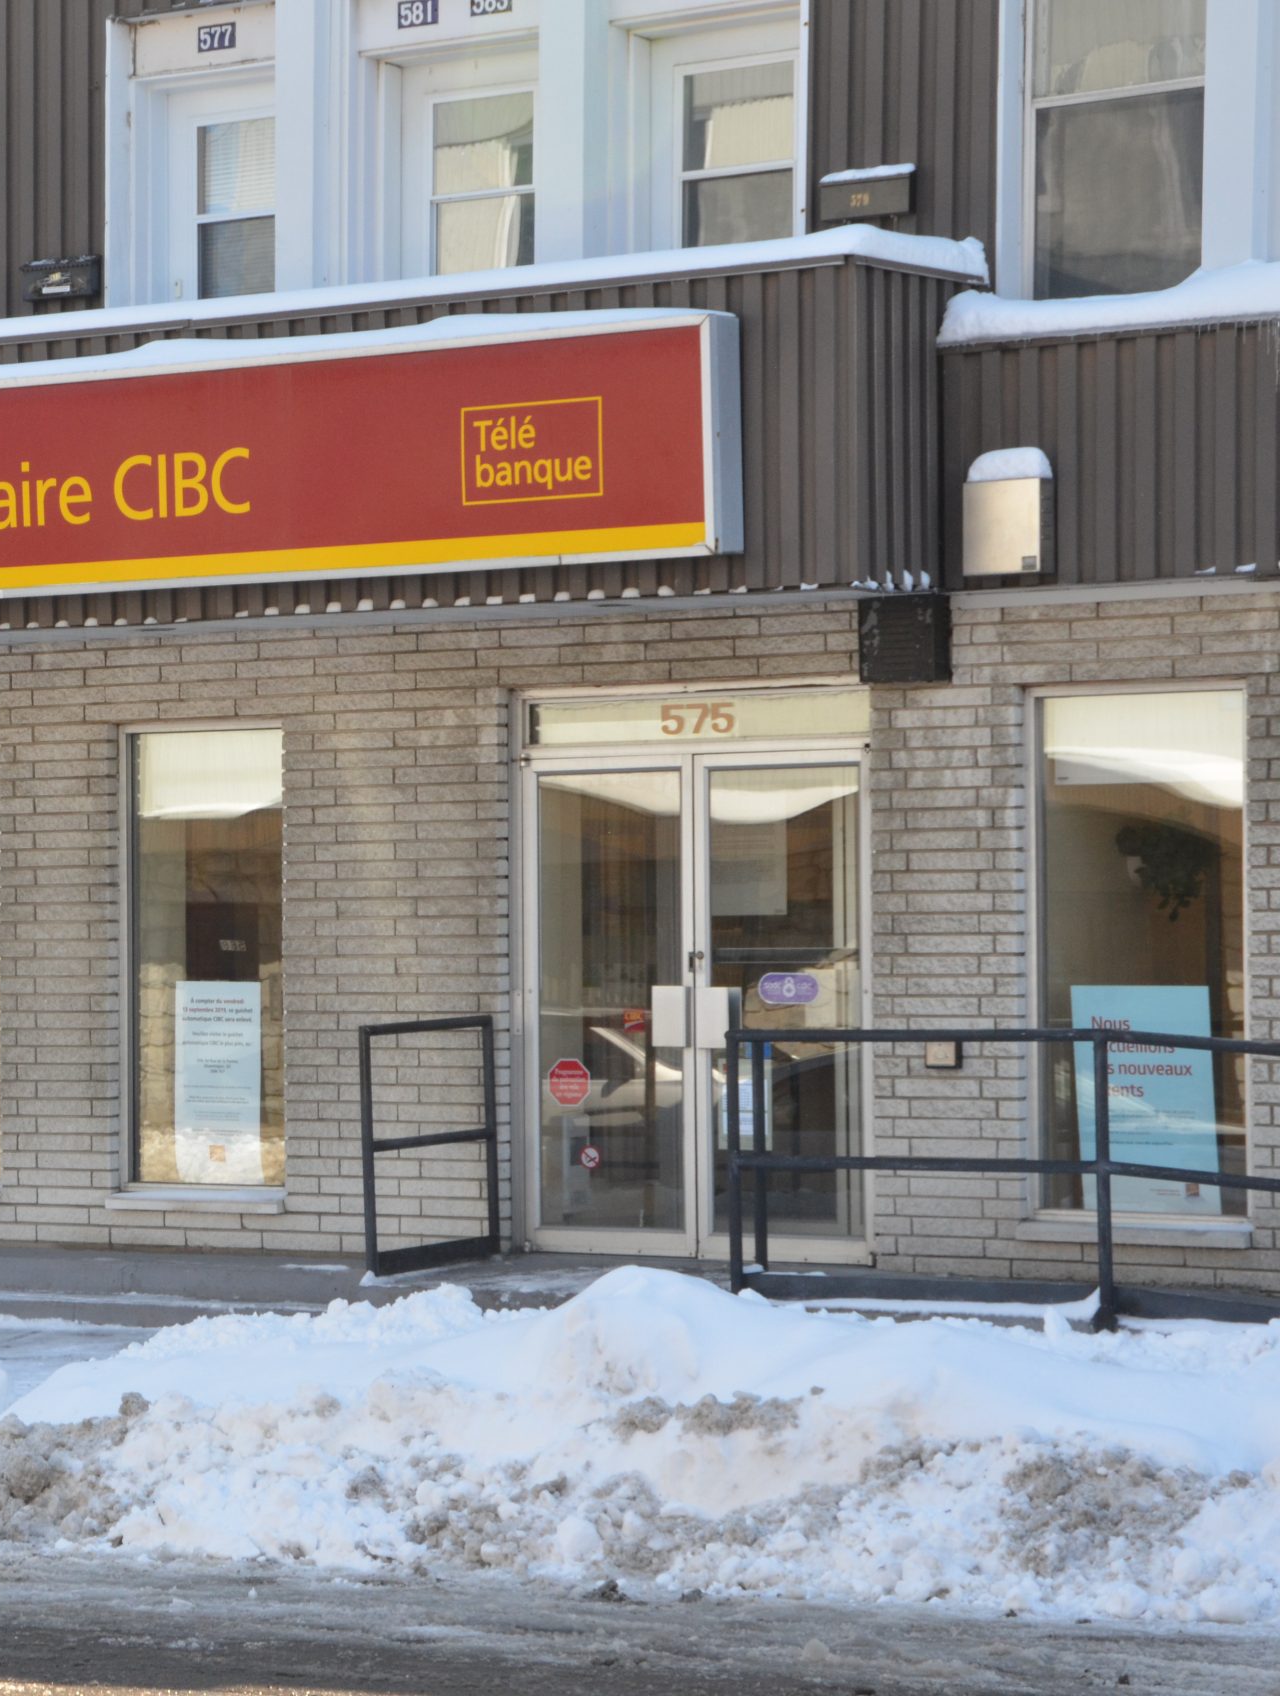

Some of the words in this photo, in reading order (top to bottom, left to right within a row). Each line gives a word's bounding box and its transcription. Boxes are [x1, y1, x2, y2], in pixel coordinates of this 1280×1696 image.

[400, 1, 433, 26] 581
[200, 24, 232, 50] 577
[475, 415, 536, 452] Télé
[115, 448, 251, 521] CIBC
[476, 457, 593, 489] banque
[661, 702, 735, 735] 575
[1091, 1016, 1130, 1031] Nous
[1118, 1063, 1193, 1076] nouveaux
